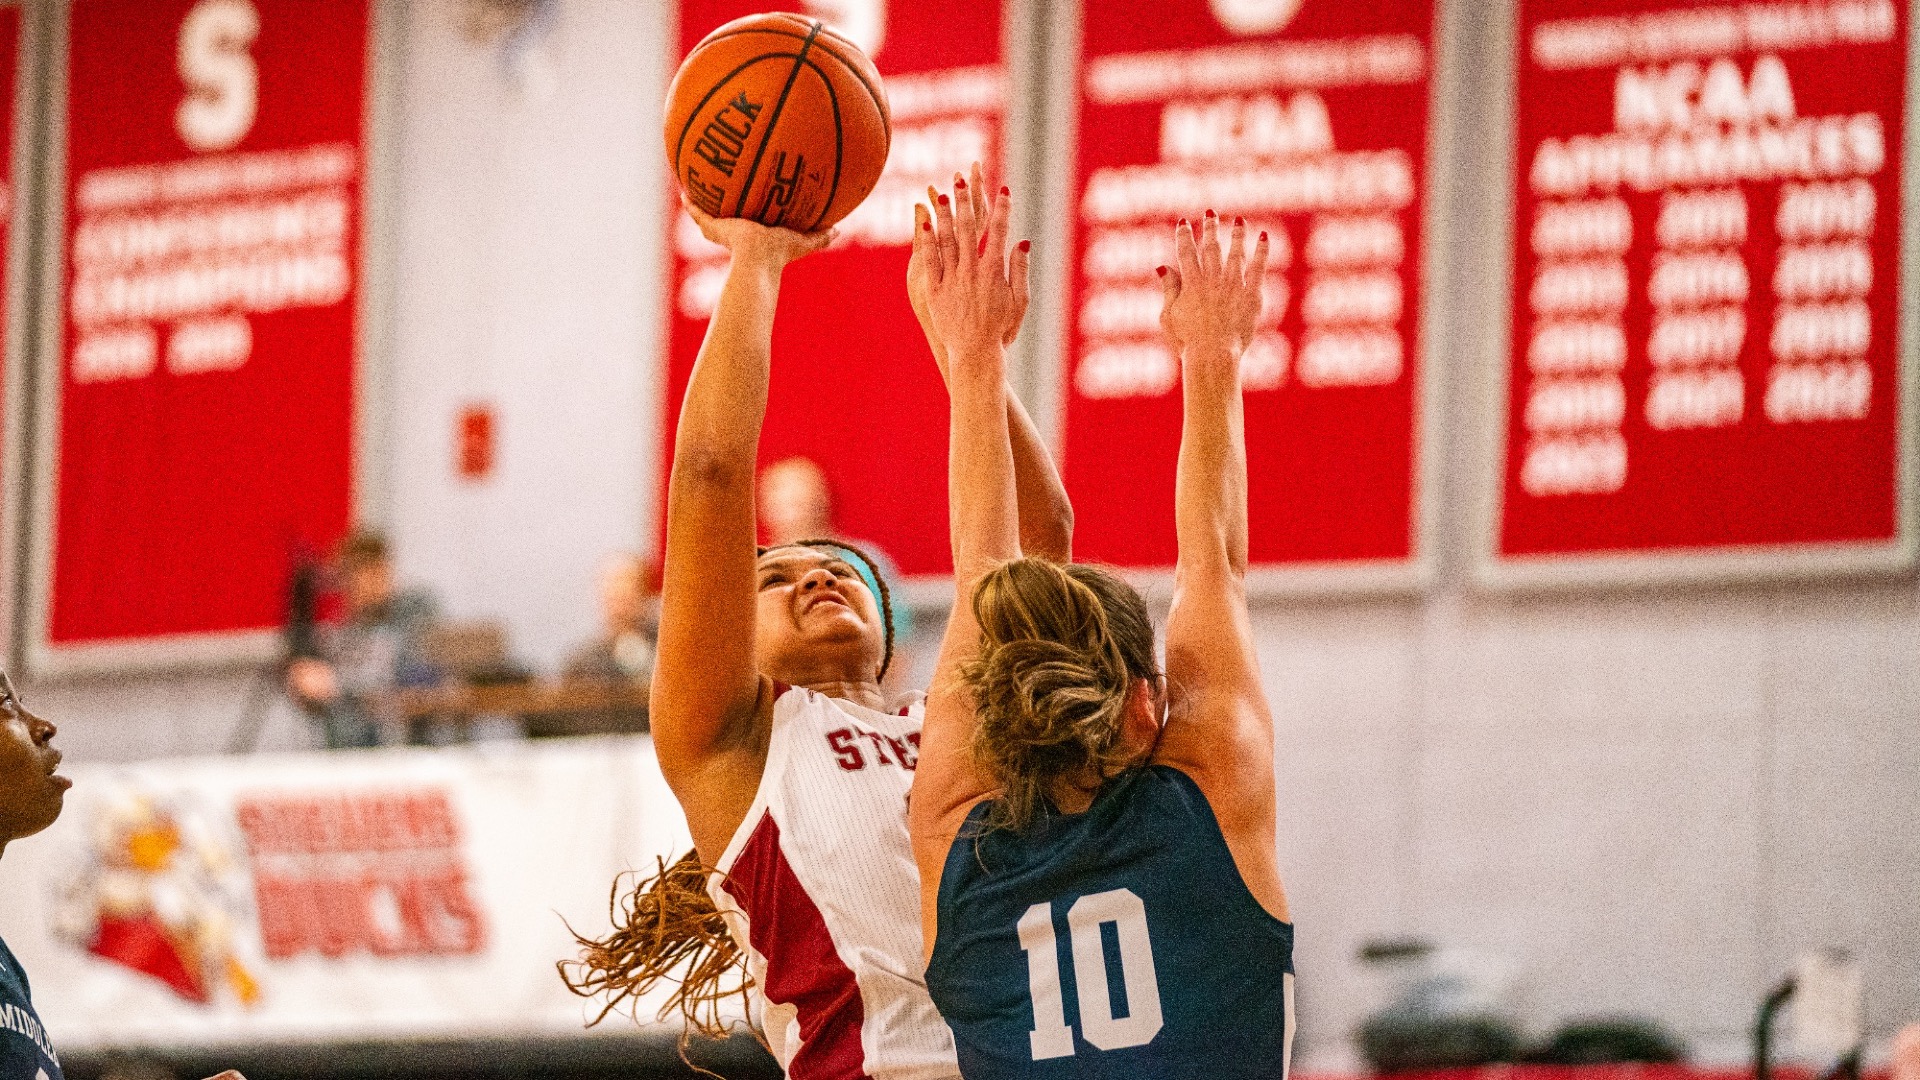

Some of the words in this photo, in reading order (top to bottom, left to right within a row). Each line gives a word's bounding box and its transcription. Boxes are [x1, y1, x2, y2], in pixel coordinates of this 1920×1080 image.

[1614, 55, 1795, 131] NCAA
[694, 91, 763, 178] ROCK
[1530, 114, 1883, 192] APPEARANCES
[825, 724, 921, 772] STE
[1017, 888, 1164, 1061] 10
